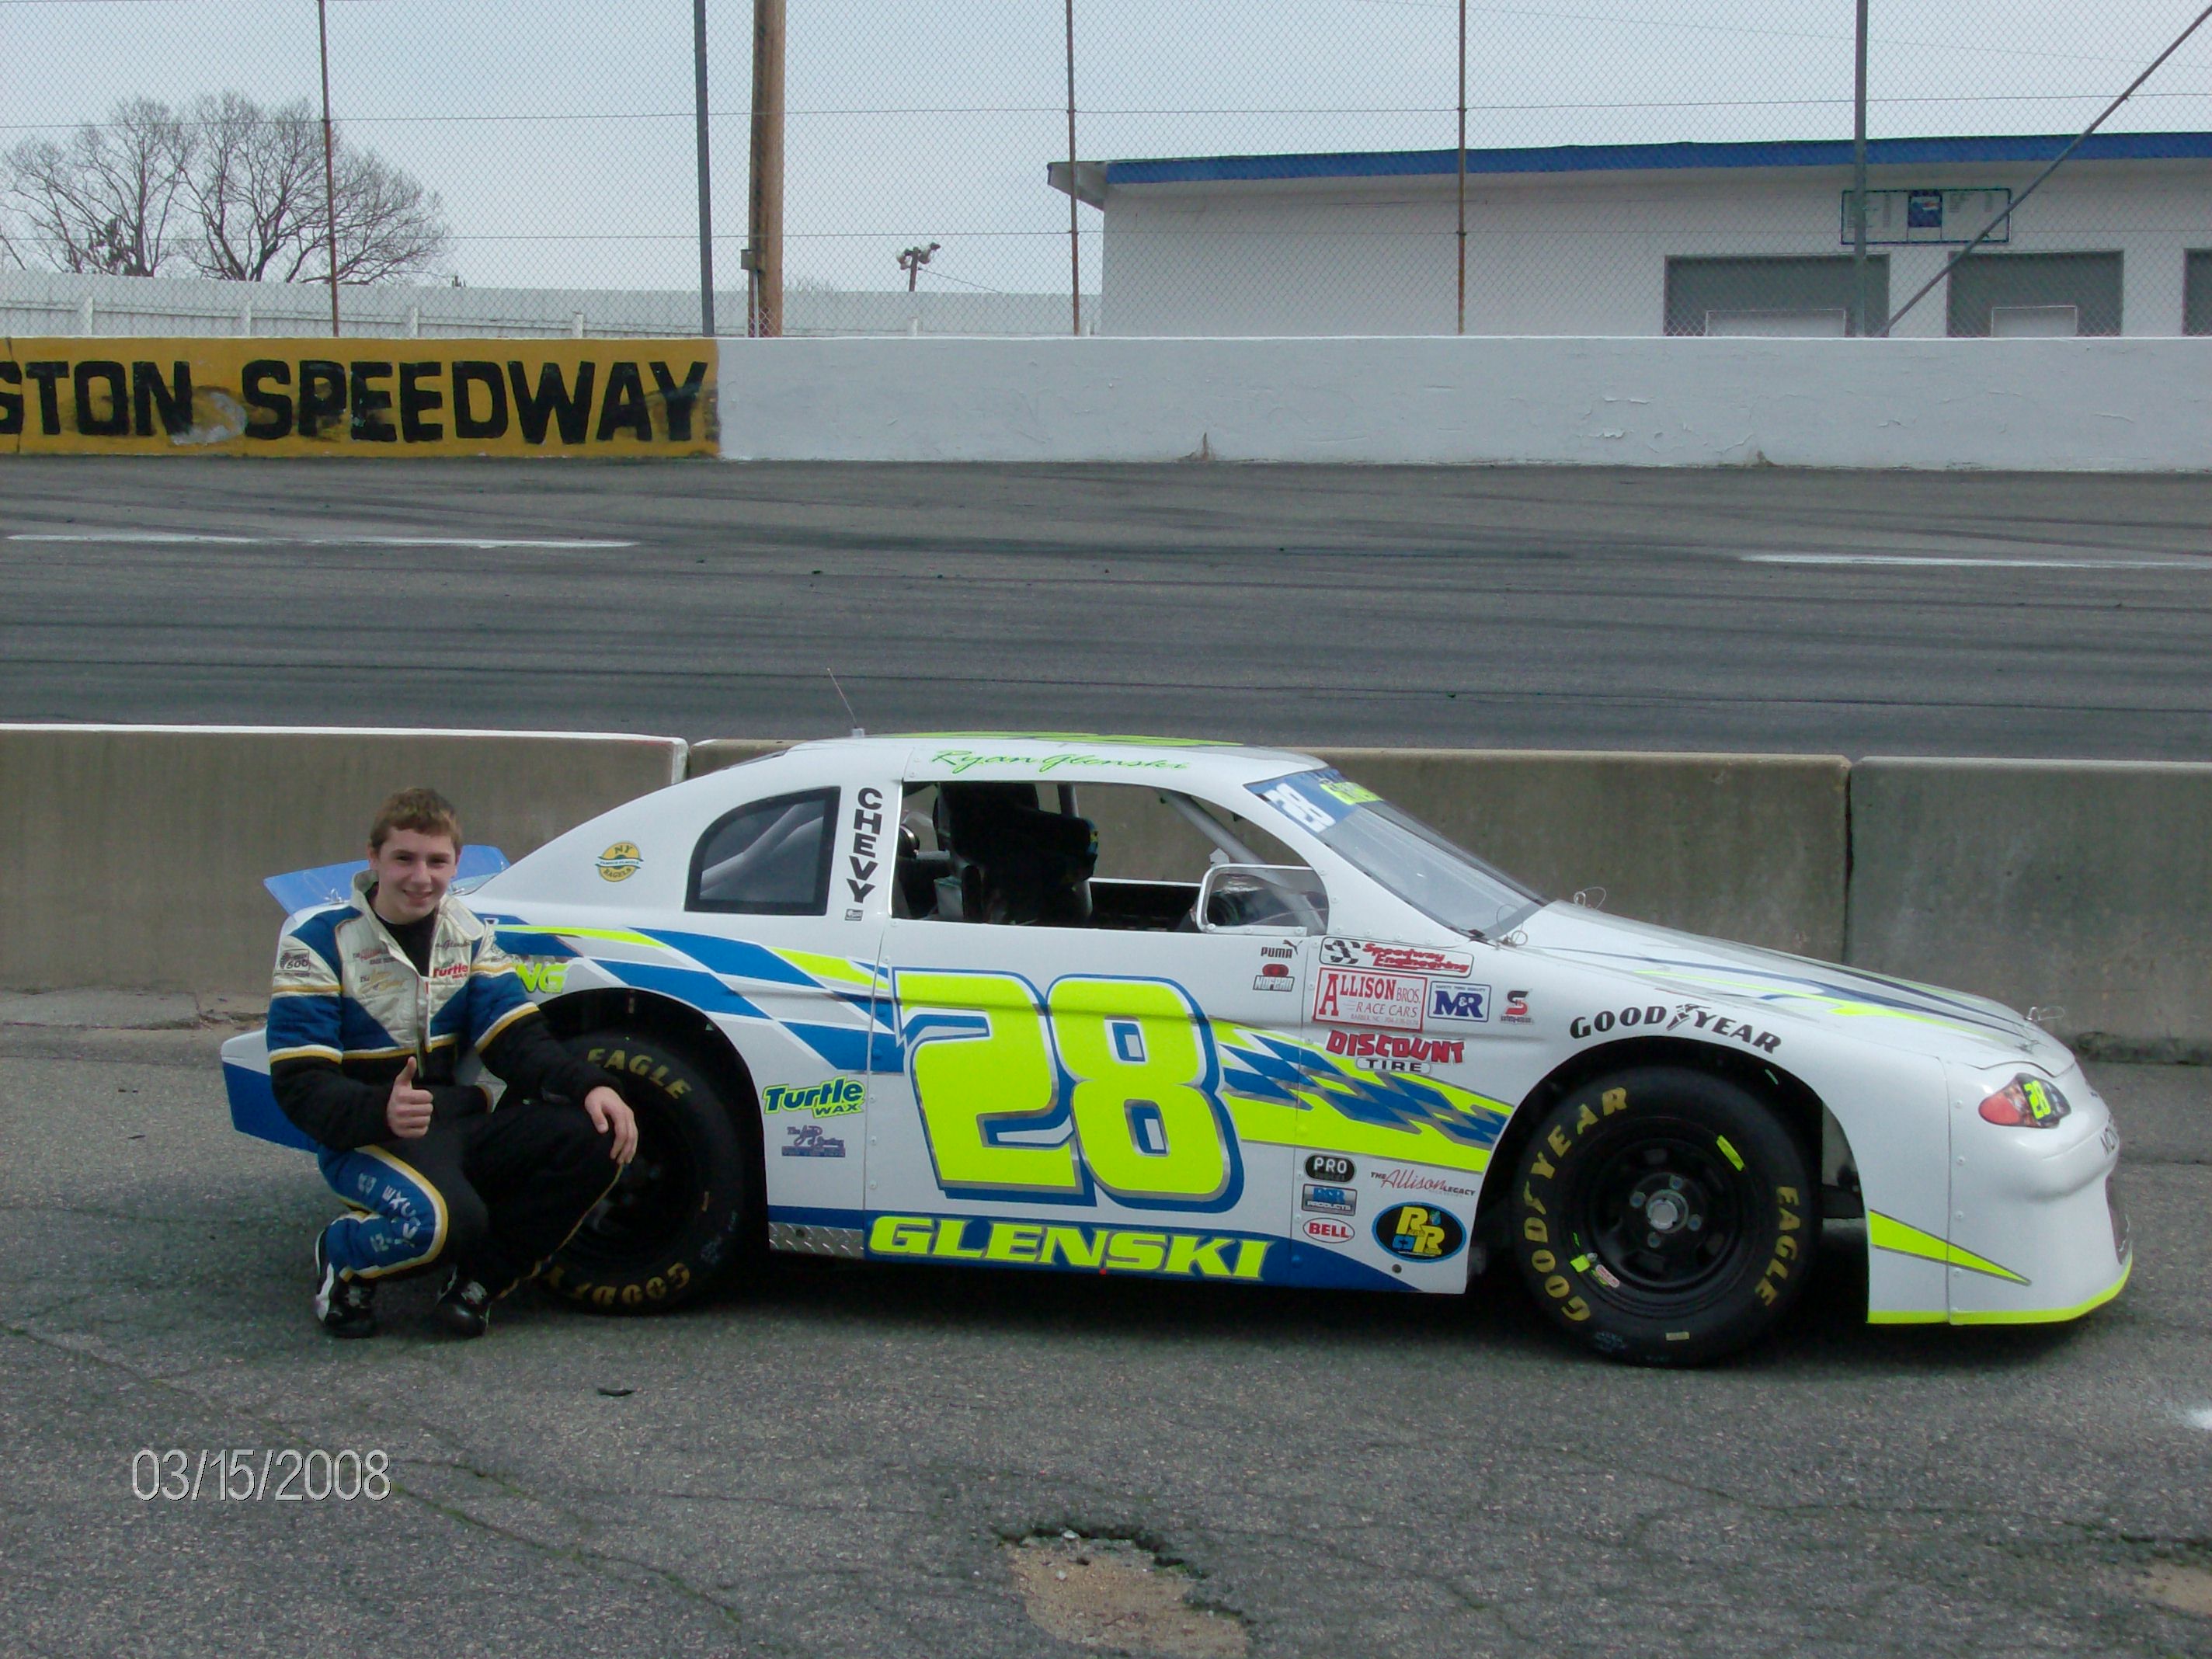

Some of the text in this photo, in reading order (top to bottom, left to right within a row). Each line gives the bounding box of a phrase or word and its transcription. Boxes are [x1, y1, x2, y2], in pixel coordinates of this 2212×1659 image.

[239, 360, 710, 444] SPEEDWAY
[931, 750, 1191, 774] Ryan Glenski
[846, 787, 883, 904] CHEVY
[1261, 947, 1293, 959] PUMA
[1363, 941, 1446, 962] Speedway
[1318, 973, 1397, 1017] ALLISON
[1355, 1001, 1418, 1018] RACE CARS
[1325, 1030, 1466, 1065] DISCOUNT
[586, 1046, 694, 1101] EAGLE
[1365, 1058, 1423, 1073] TIRE
[765, 1077, 864, 1112] Turtle
[890, 966, 1246, 1214] 28
[2022, 1080, 2051, 1120] 28
[1313, 1157, 1348, 1174] PRO
[1380, 1168, 1446, 1191] Allison
[1443, 1185, 1476, 1196] LEGACY
[868, 1215, 1272, 1279] GLENSKI
[1308, 1222, 1350, 1239] BELL
[1755, 1185, 1801, 1307] EAGLE
